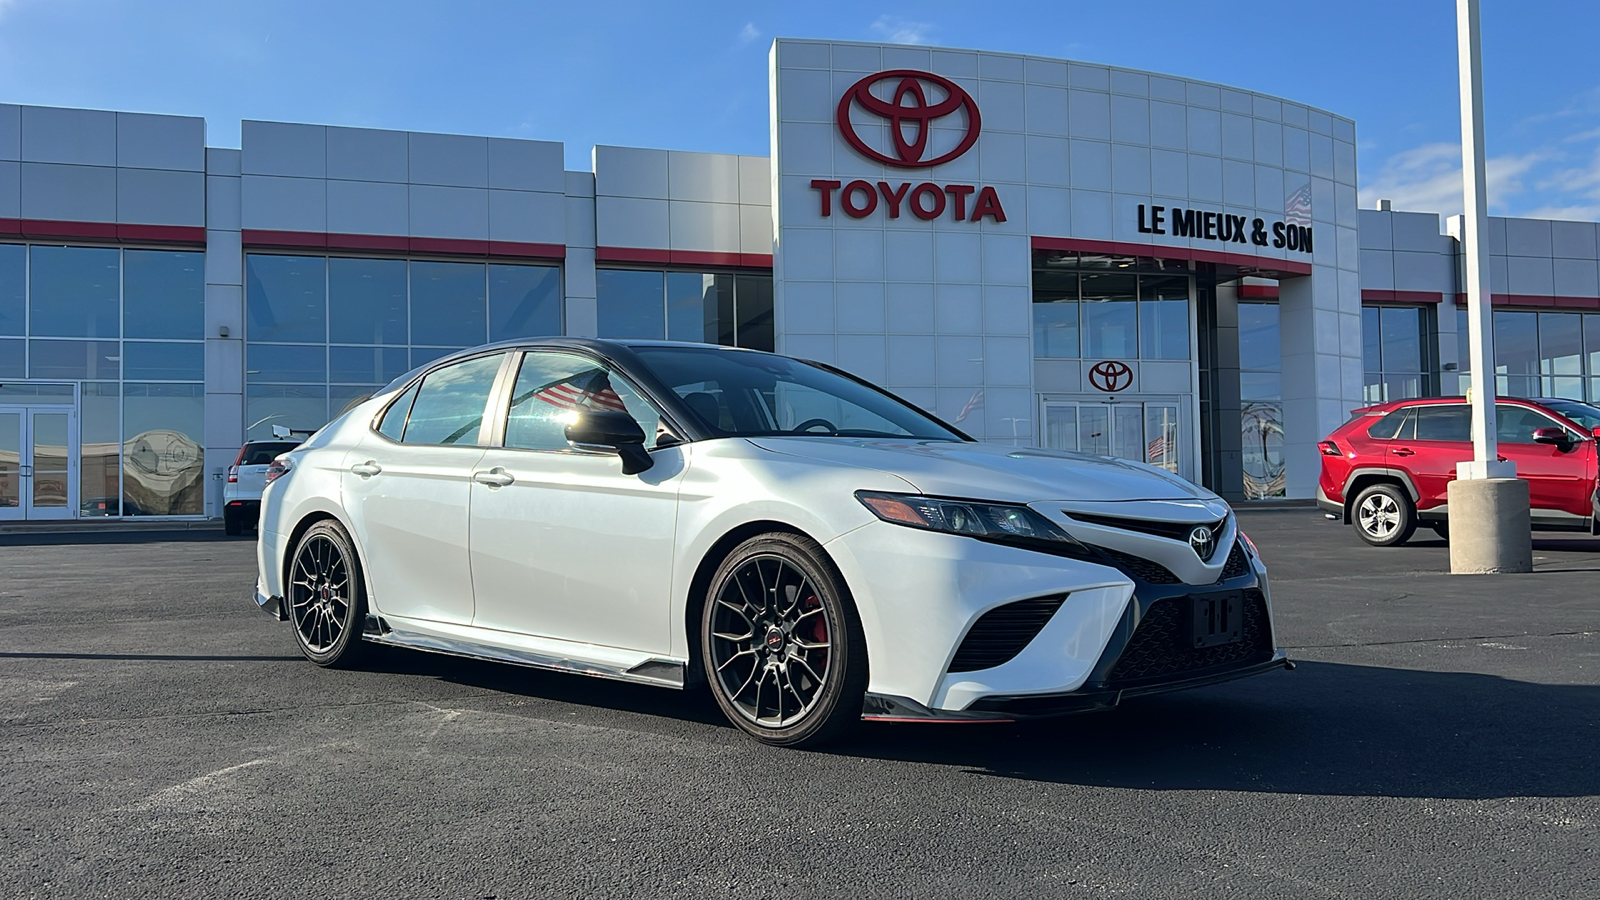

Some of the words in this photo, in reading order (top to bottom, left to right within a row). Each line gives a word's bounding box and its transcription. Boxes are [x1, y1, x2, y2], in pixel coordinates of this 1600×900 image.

[810, 179, 1007, 222] TOYOTA
[1137, 204, 1166, 234] LE
[1173, 208, 1247, 243] MIEUX
[1252, 218, 1269, 246] &
[1273, 222, 1313, 253] SON
